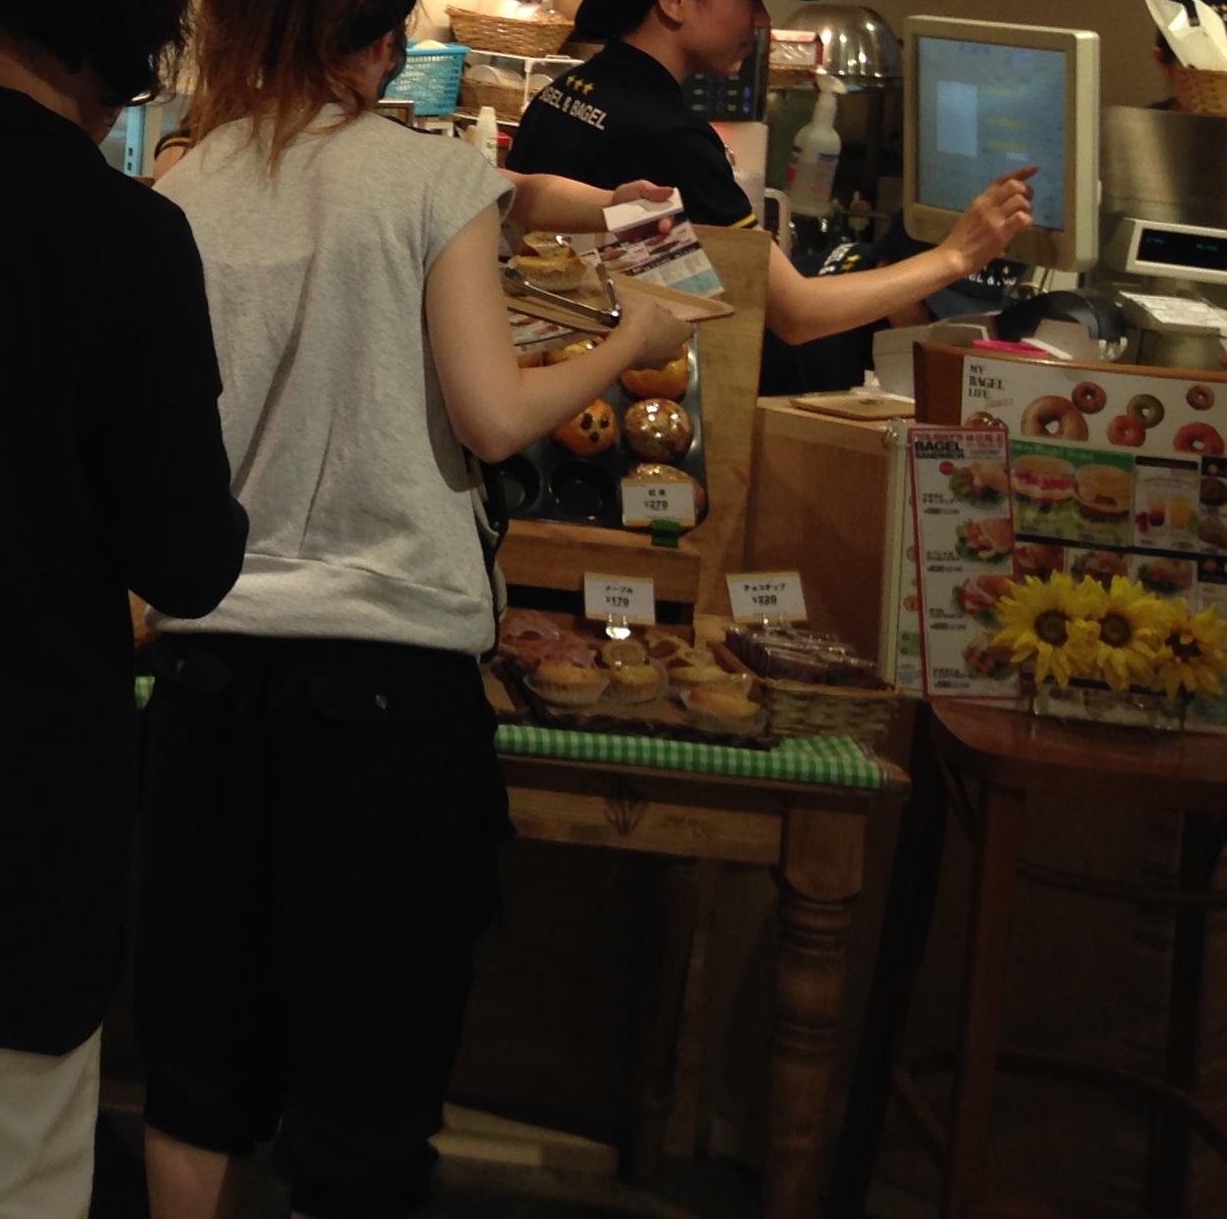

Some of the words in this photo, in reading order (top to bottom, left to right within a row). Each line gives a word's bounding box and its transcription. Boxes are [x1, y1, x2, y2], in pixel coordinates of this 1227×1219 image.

[569, 99, 607, 131] BAGEL
[969, 364, 985, 375] MY
[968, 375, 1005, 391] BAGEL
[968, 388, 989, 400] LIFE
[915, 440, 963, 452] BAGEL
